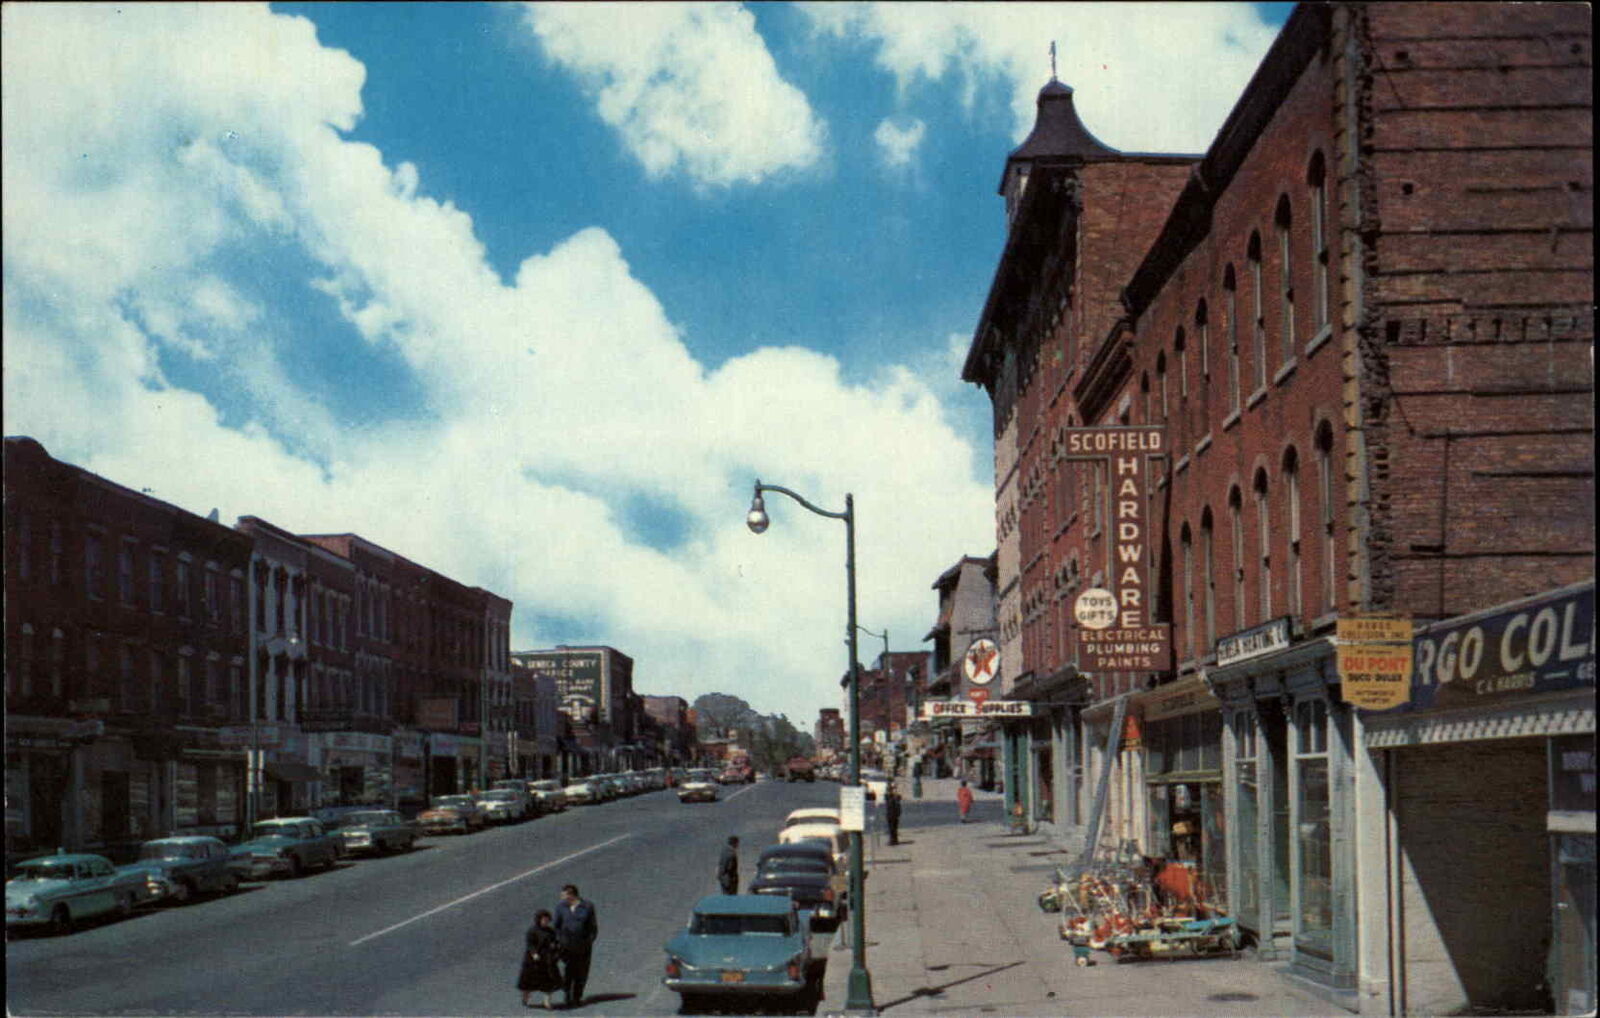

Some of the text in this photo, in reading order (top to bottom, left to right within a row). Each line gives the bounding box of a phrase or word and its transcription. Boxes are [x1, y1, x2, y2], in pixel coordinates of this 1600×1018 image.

[1070, 431, 1161, 451] SCOFIELD
[1118, 457, 1143, 629] HARDWARE
[1081, 597, 1113, 607] TOYS
[1079, 609, 1115, 621] GIFTS
[1081, 630, 1166, 641] ELECTRICAL
[1087, 642, 1161, 655] PLUMBING
[1416, 602, 1596, 685] RGO COL
[1098, 656, 1150, 669] PAINTS
[1343, 657, 1409, 672] DU PONT
[932, 703, 1023, 715] OFFICE SUPPLIES
